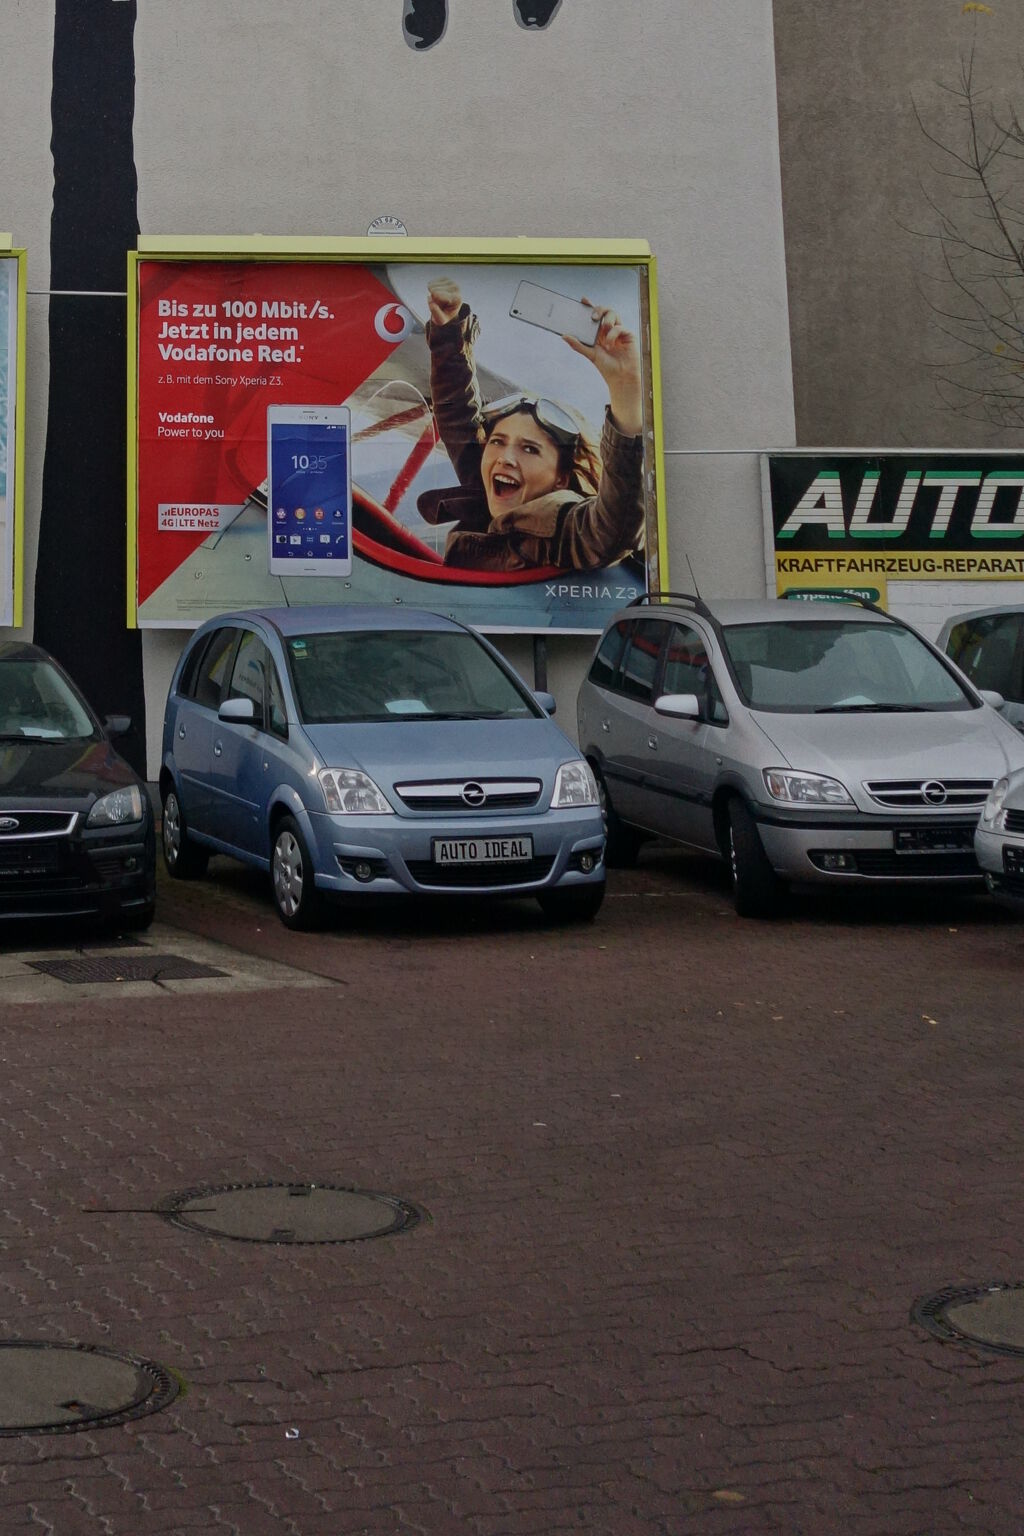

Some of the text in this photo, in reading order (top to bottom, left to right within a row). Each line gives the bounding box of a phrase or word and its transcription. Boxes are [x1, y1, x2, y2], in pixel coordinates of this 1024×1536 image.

[158, 299, 335, 320] Bis zu 100 Mbit/s.
[158, 322, 299, 345] Jetzt in jedem
[158, 344, 254, 362] Vodafone
[176, 375, 191, 385] mit
[193, 375, 214, 386] dem
[215, 375, 238, 387] Sony
[239, 376, 268, 387] Xperia
[159, 412, 214, 424] Vodafone
[158, 426, 225, 440] Power to you
[777, 470, 1024, 539] AUTO
[171, 507, 220, 518] EUROPAS
[197, 518, 220, 528] Netz
[778, 558, 1024, 573] KRAFTFAHRZEUG-REPARAT
[545, 584, 637, 600] XPERIA Z3
[440, 841, 527, 860] AUTO IDEAL
